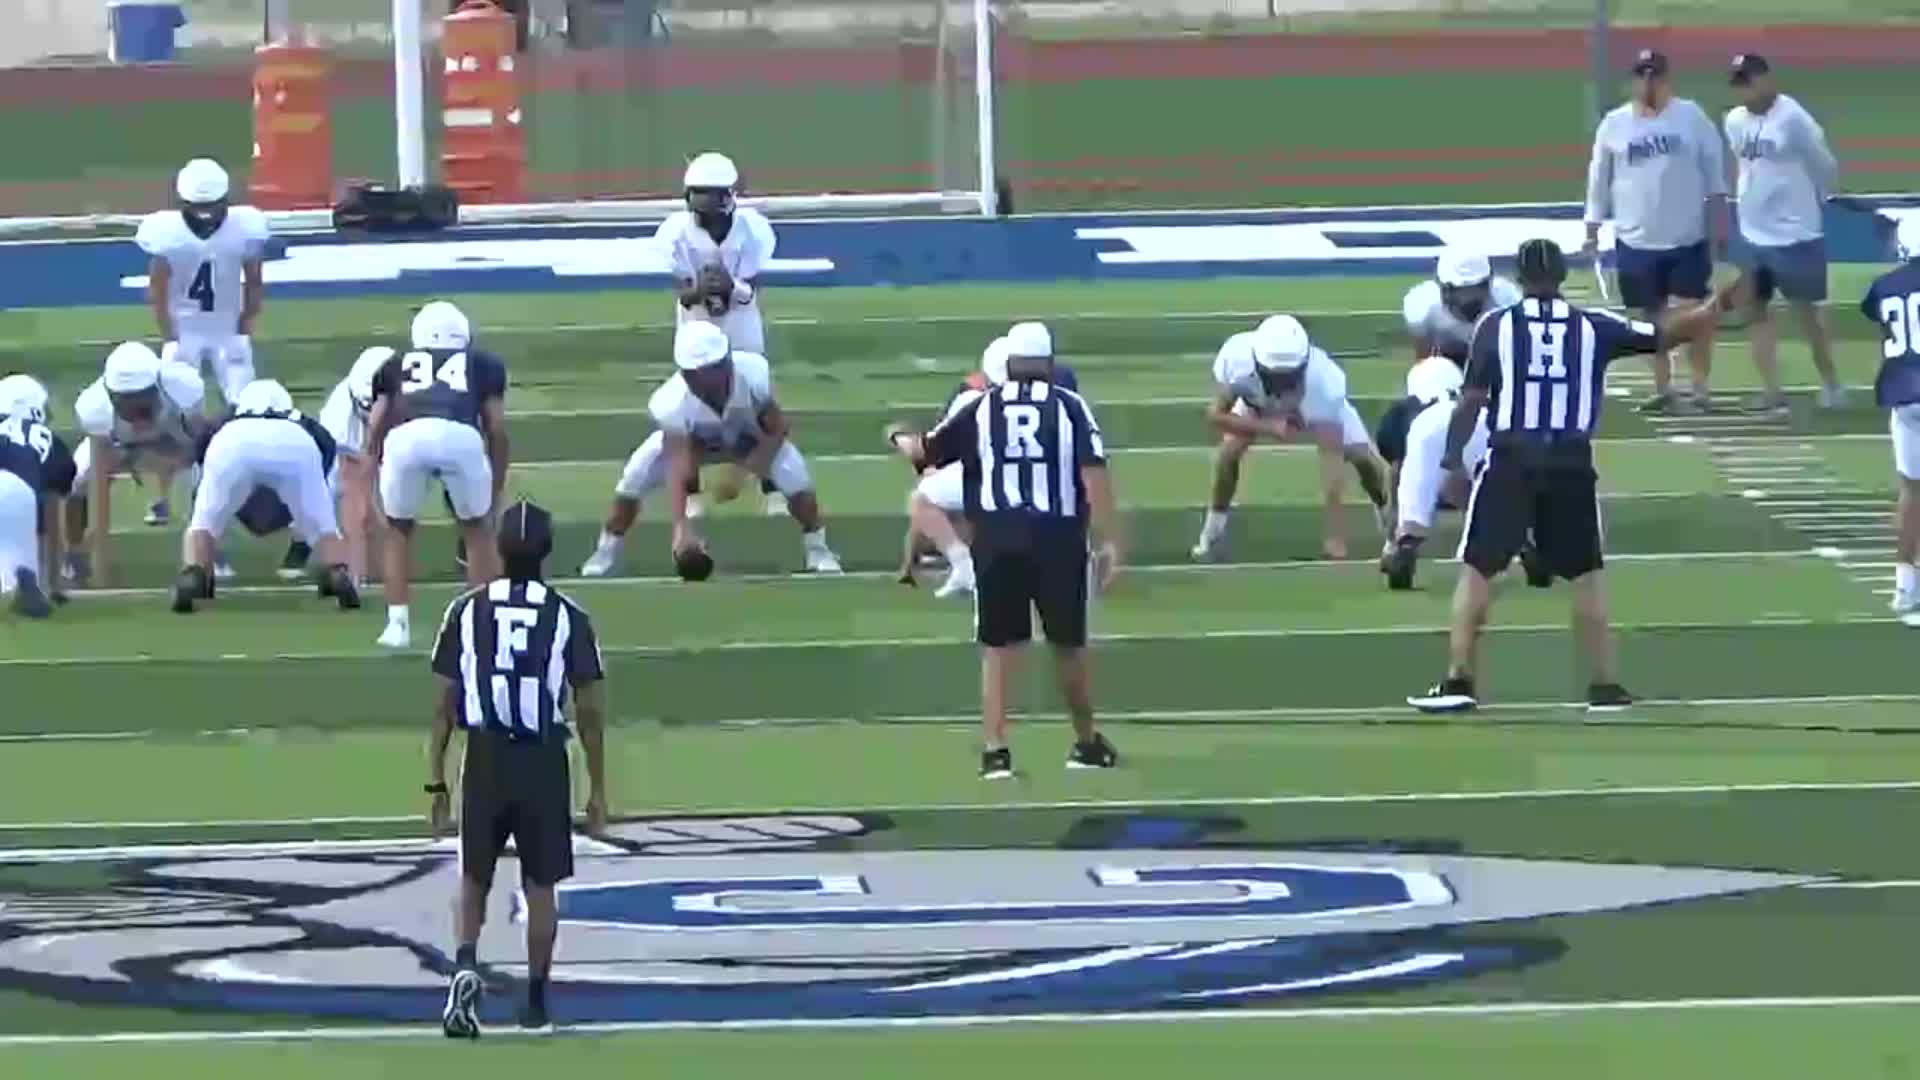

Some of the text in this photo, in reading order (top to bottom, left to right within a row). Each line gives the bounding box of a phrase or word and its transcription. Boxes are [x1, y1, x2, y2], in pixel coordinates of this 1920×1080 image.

[187, 260, 215, 312] 4
[401, 351, 468, 394] 34
[1527, 321, 1568, 379] H
[1003, 404, 1044, 459] R
[494, 606, 538, 670] F
